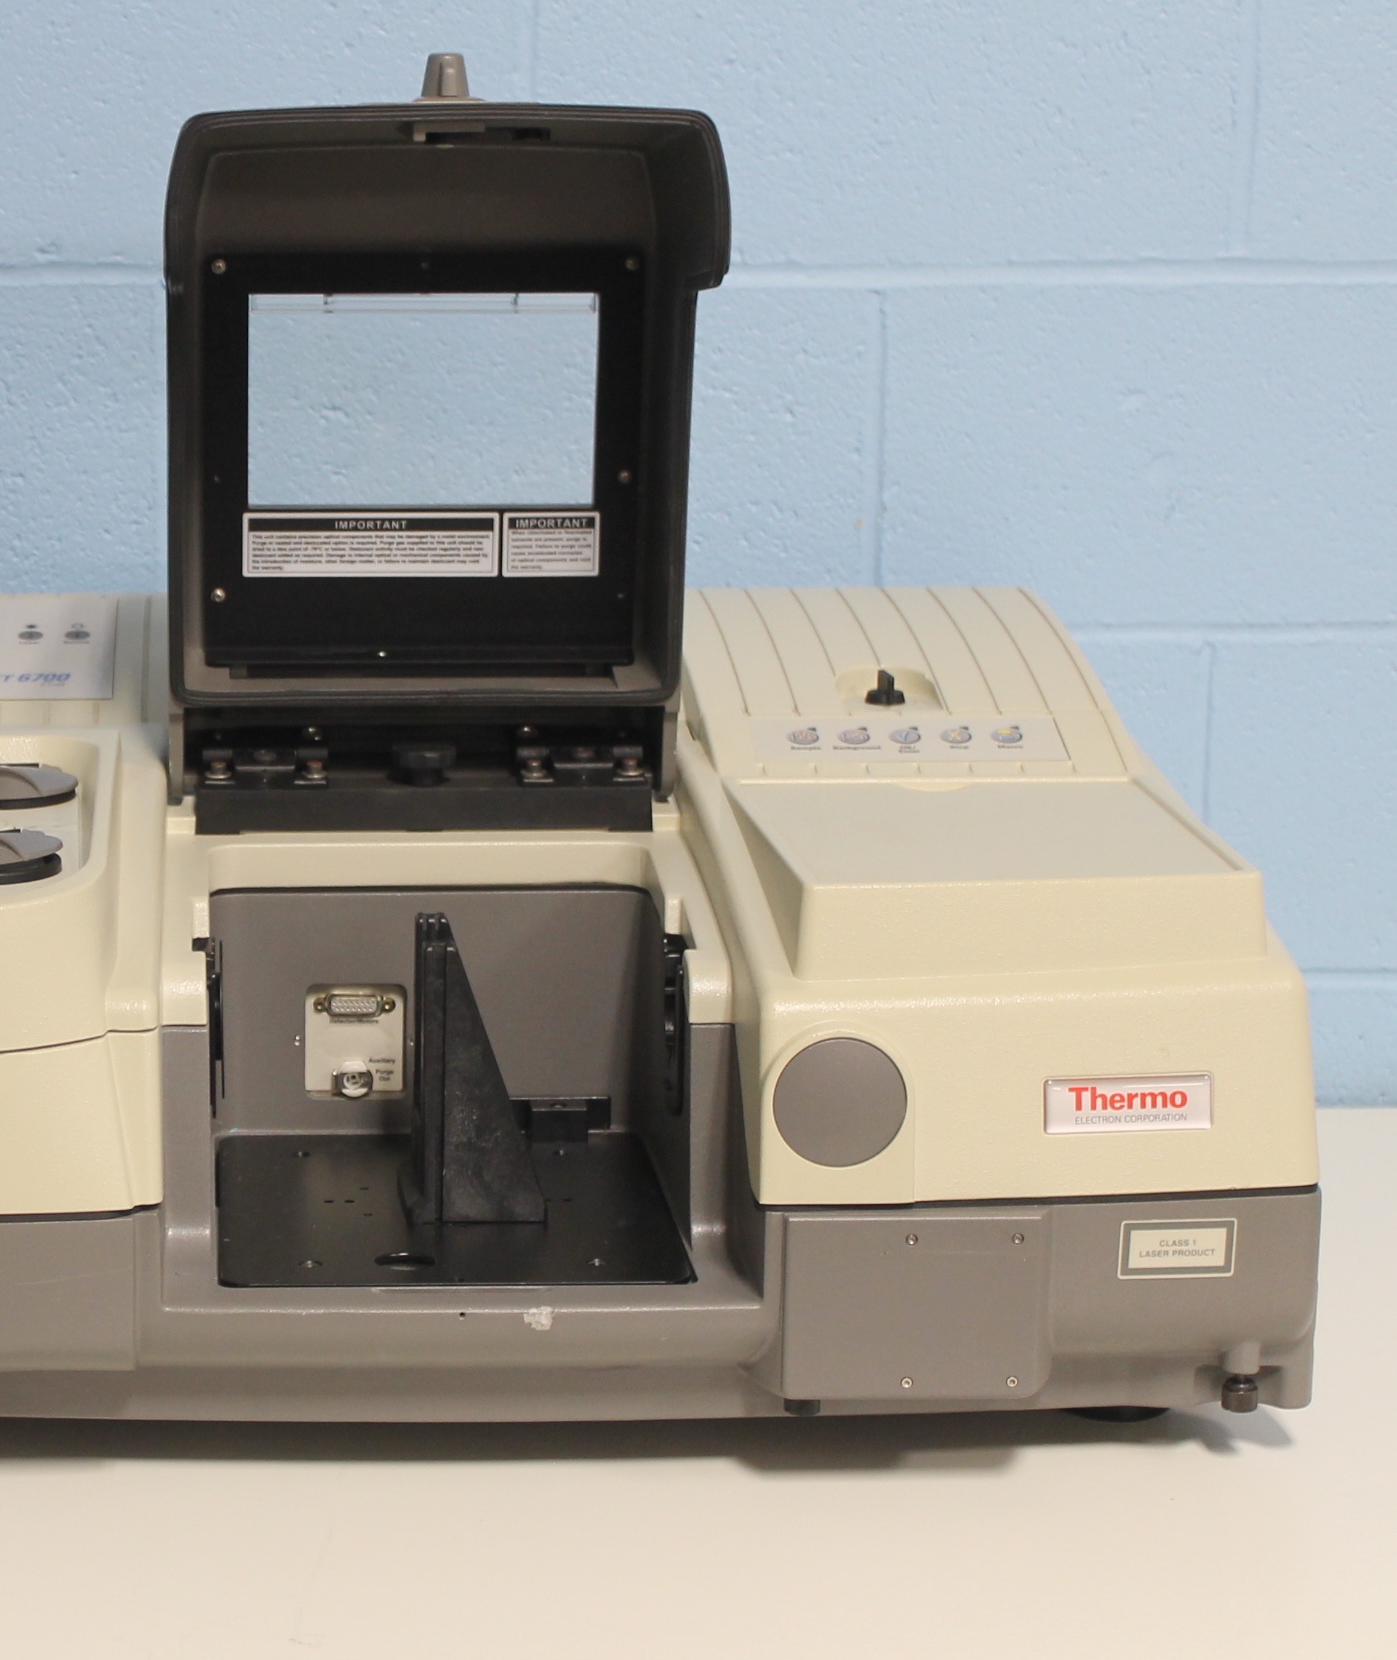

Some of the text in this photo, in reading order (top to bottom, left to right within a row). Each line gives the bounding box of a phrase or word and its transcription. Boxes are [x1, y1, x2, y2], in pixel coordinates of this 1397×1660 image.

[335, 520, 407, 529] IMPORTANT
[515, 519, 588, 528] IMPORTANT
[17, 673, 71, 682] 6700
[1068, 1086, 1188, 1111] Thermo
[1075, 1113, 1188, 1125] ELECTRON CORPORATION
[1139, 1249, 1216, 1258] LASER PRODUCT
